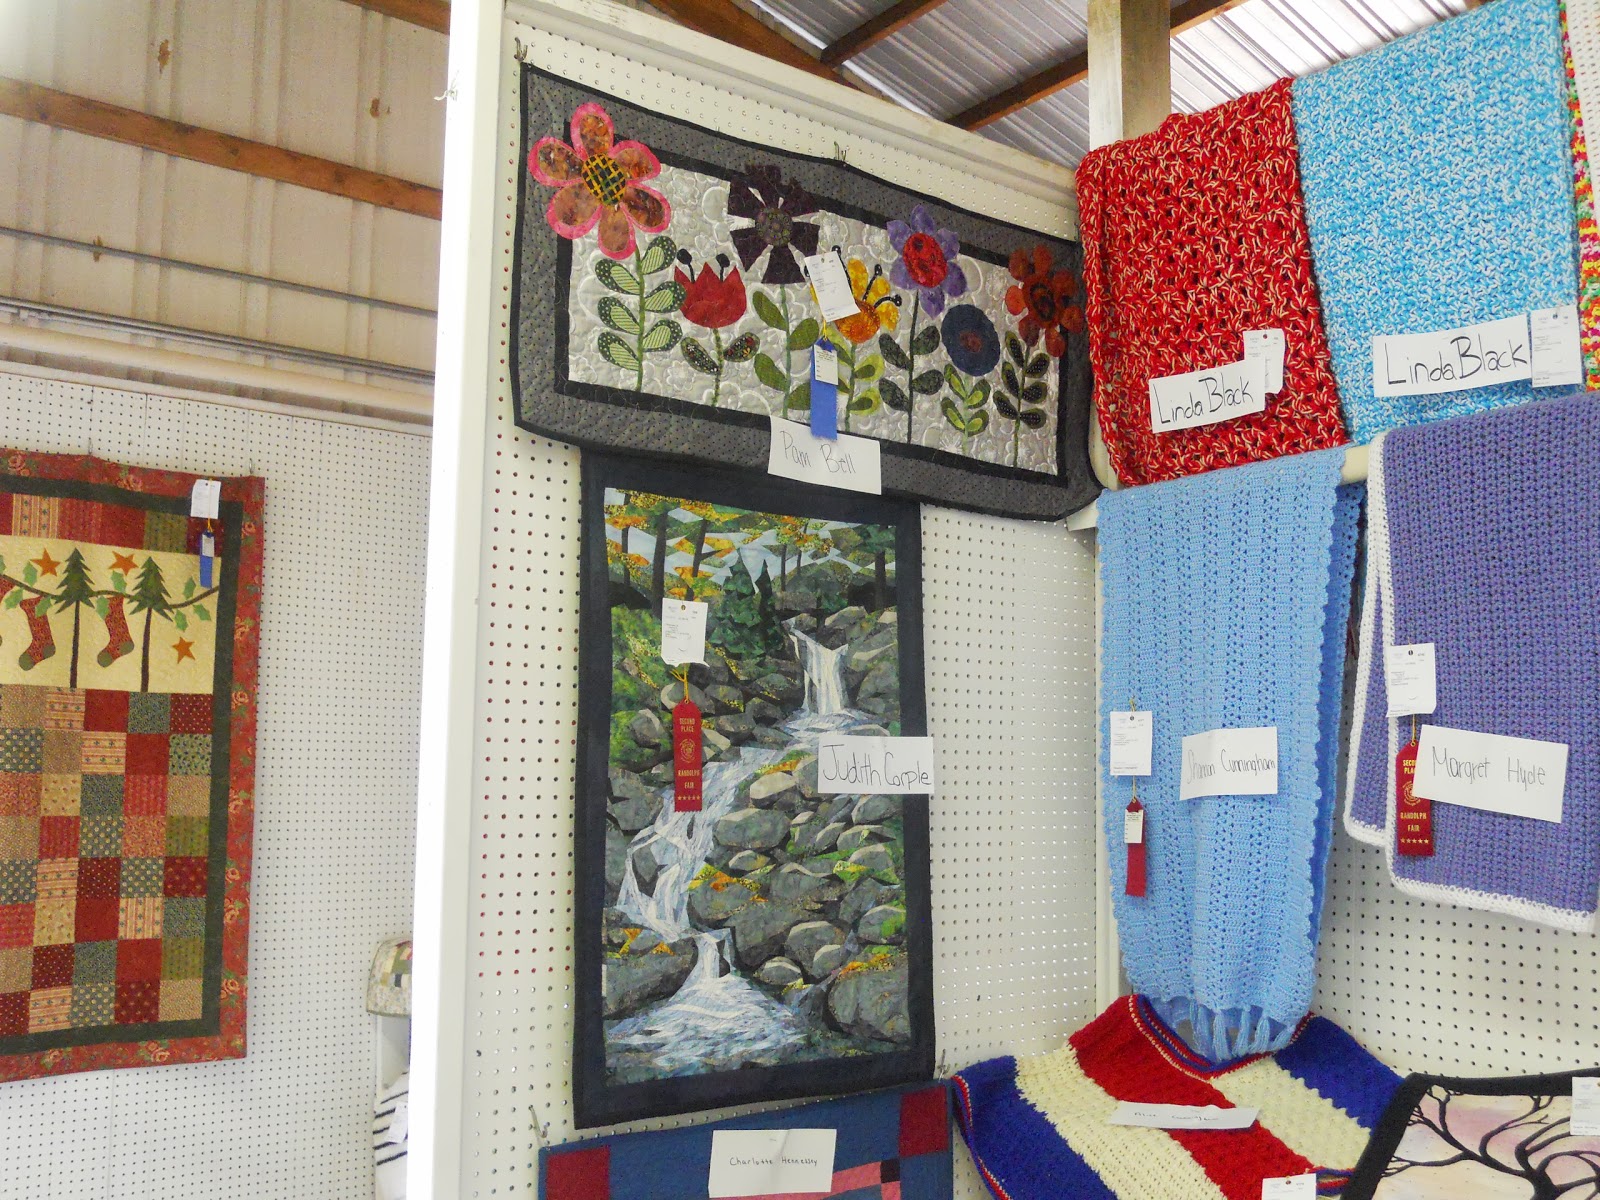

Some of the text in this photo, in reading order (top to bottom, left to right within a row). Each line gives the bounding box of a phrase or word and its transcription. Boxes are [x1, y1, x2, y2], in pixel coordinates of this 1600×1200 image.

[1384, 342, 1457, 385] Linda
[1450, 333, 1528, 380] Black
[1152, 371, 1254, 424] Linda Black
[780, 430, 857, 474] Pam Bell
[679, 717, 696, 725] SECOND
[681, 725, 694, 733] PLACE
[823, 743, 882, 786] Judith
[678, 769, 700, 777] RANDOLPH
[1507, 756, 1546, 792] Hyde
[684, 781, 695, 789] FAIR
[1400, 812, 1427, 820] RANDOLPH
[1407, 824, 1420, 832] FAIR
